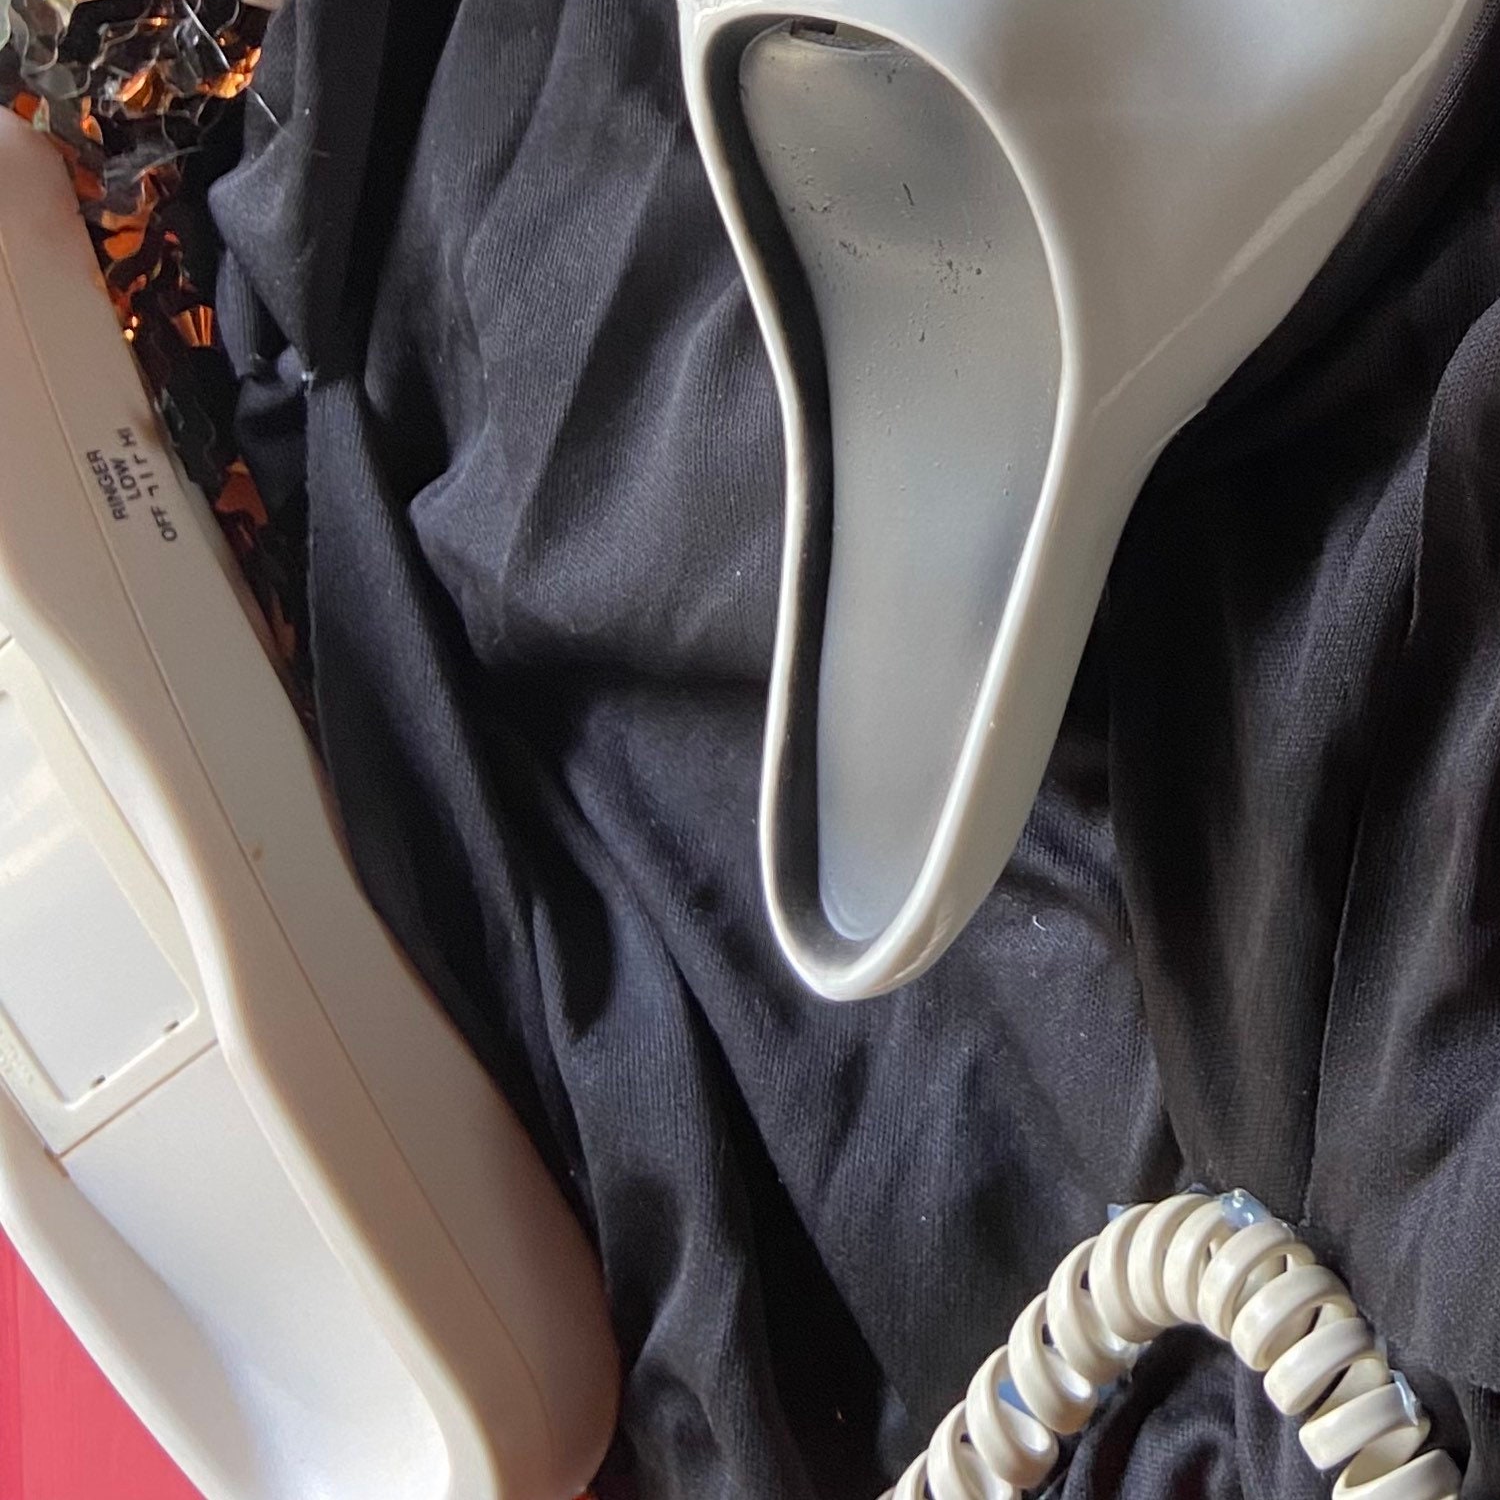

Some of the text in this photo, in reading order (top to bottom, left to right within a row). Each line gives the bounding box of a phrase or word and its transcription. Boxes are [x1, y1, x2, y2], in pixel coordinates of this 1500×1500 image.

[87, 451, 127, 520] RINGER
[111, 458, 141, 500] LOW
[151, 506, 178, 542] OFF
